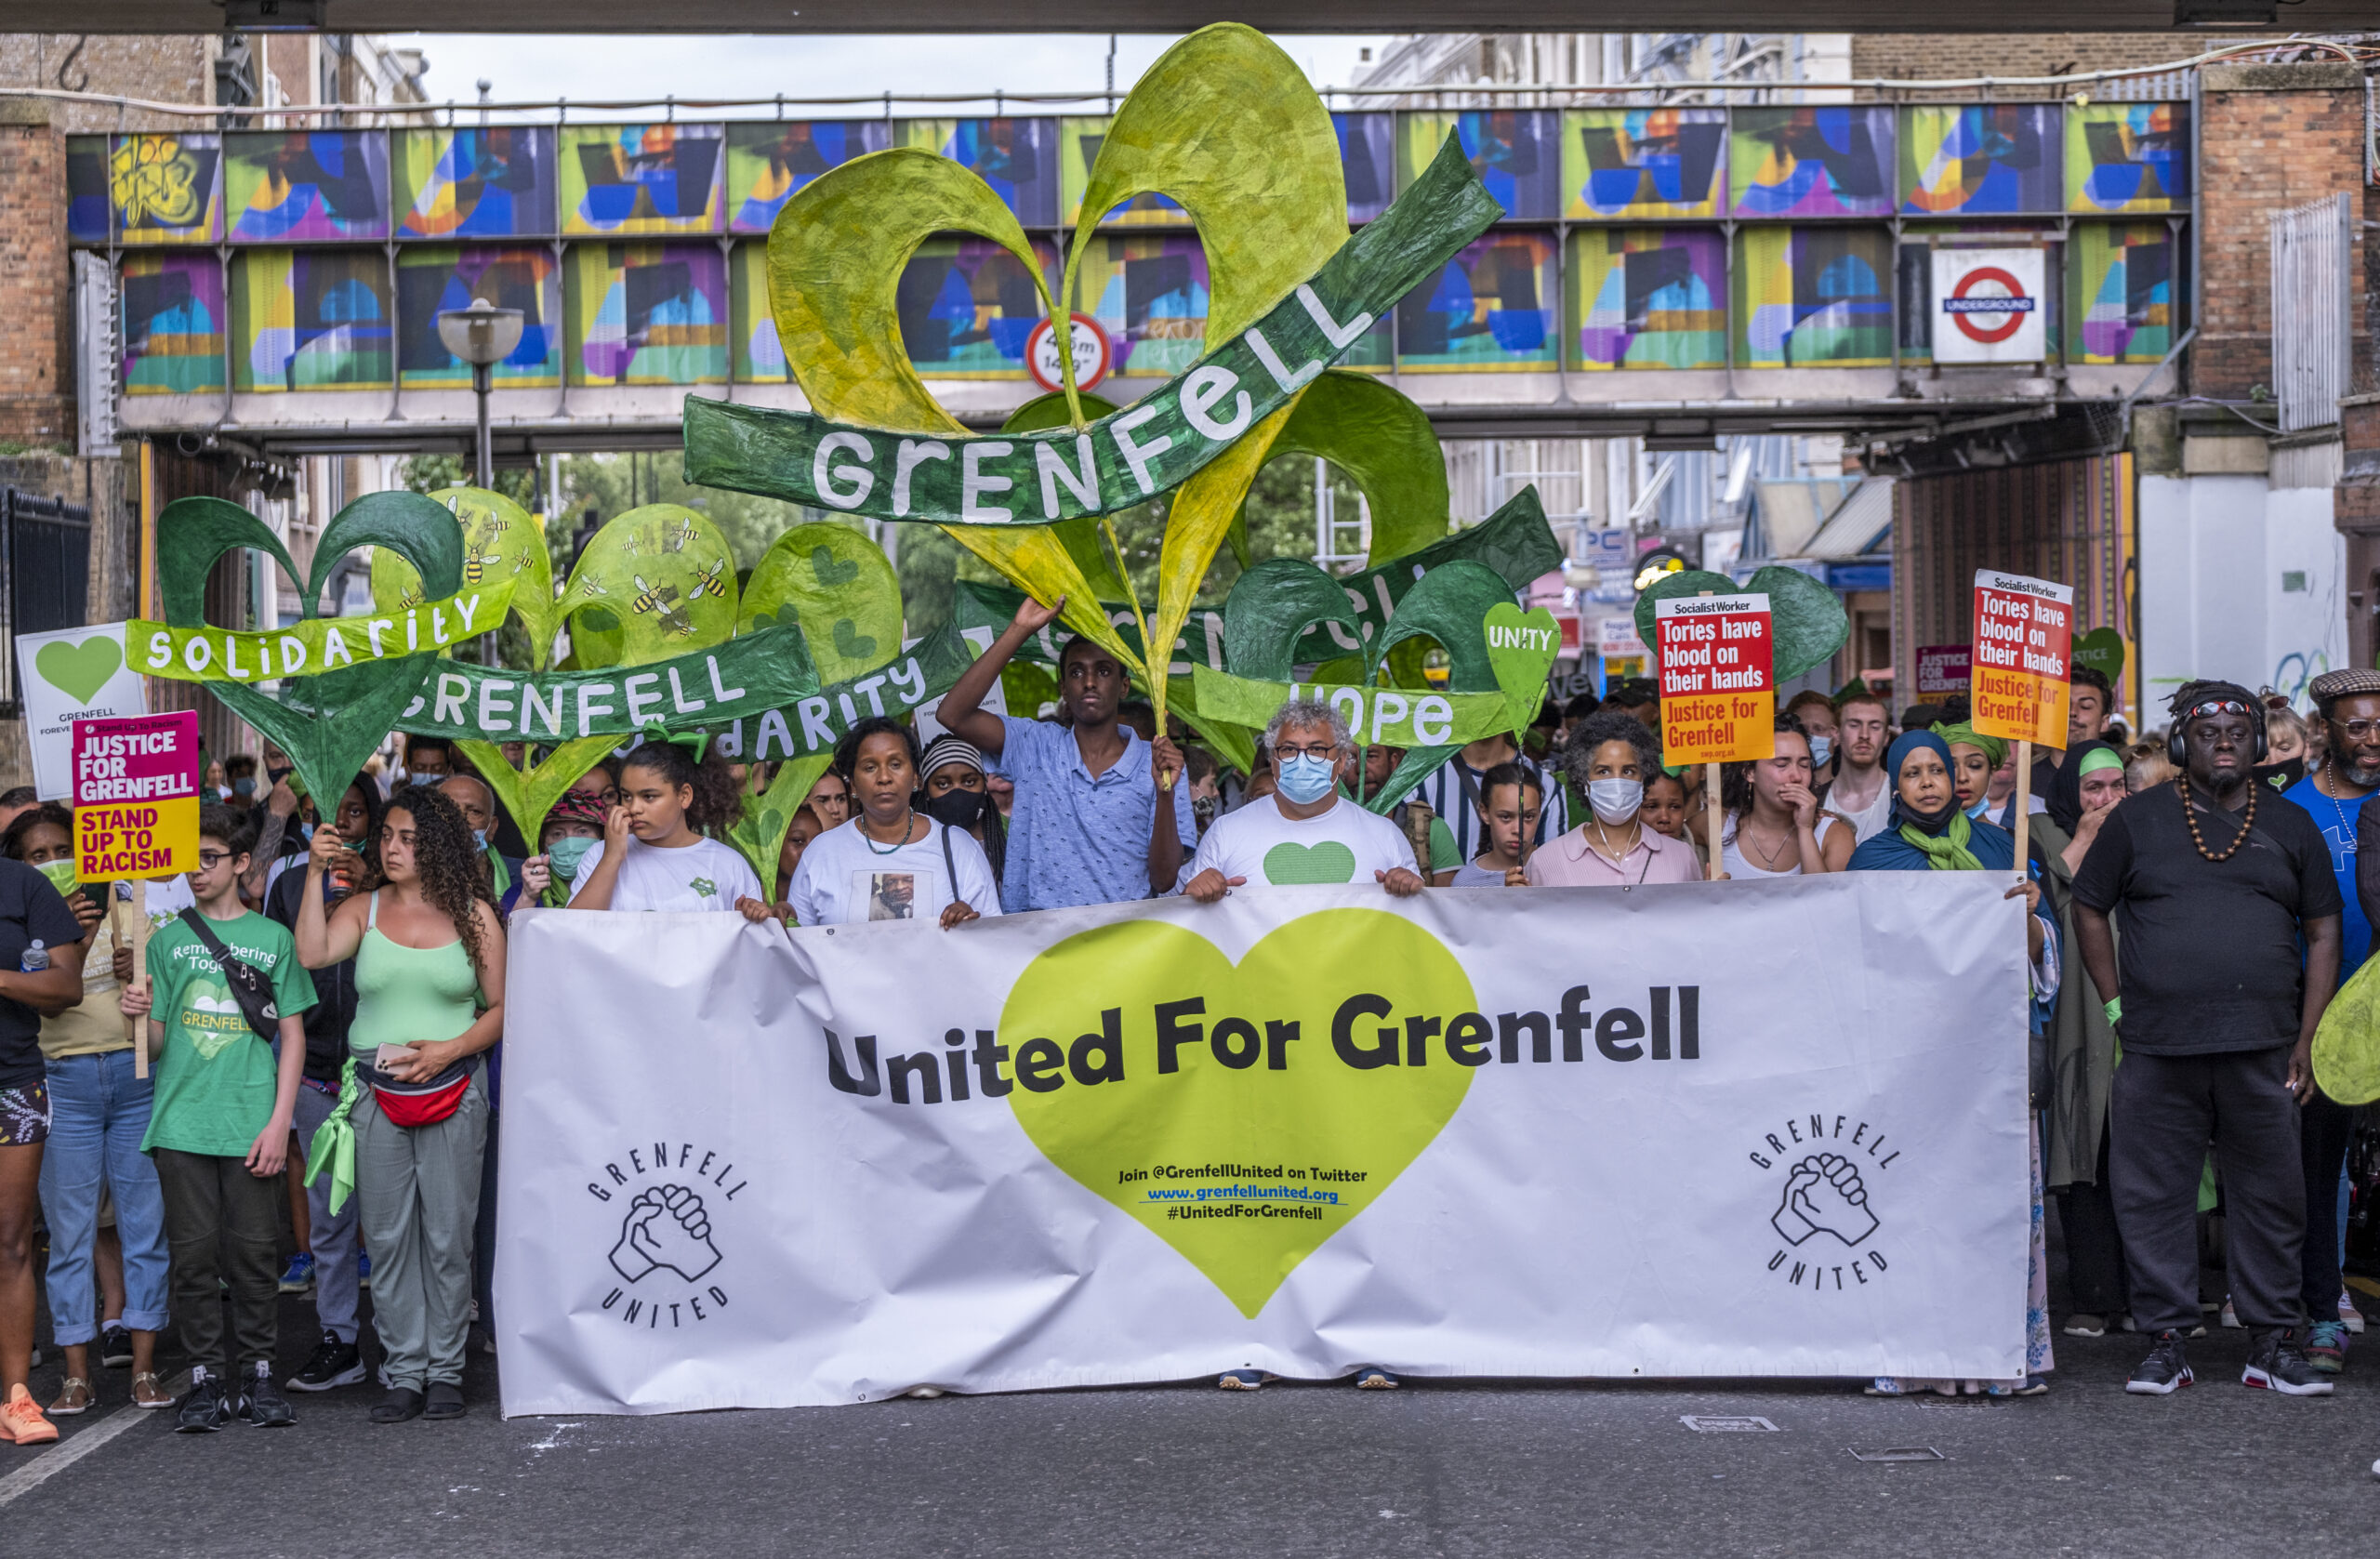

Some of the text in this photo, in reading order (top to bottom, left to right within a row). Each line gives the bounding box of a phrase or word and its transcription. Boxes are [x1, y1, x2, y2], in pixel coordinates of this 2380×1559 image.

[1945, 299, 2032, 311] UNDERGROUND
[1981, 590, 2065, 628] Tories have
[1489, 626, 1553, 652] UNITY
[1661, 616, 1763, 643] Tories have
[1980, 615, 2046, 648] blood on
[1664, 642, 1712, 667] blood
[1717, 646, 1739, 665] on
[1919, 653, 1969, 667] JUSTICE
[1979, 641, 2064, 676] their hands
[2071, 648, 2109, 662] STICE
[1664, 665, 1764, 693] their hands
[1919, 666, 1944, 679] FOR
[1978, 670, 2058, 704] Justice for
[59, 707, 116, 722] GRENFELL
[1667, 697, 1758, 723] Justice for
[1977, 695, 2039, 725] Grenfell
[40, 726, 71, 735] FOREVE
[97, 723, 123, 733] Stand
[139, 722, 150, 731] To
[151, 719, 182, 729] Racism
[1668, 721, 1735, 748] Grenfell
[79, 731, 177, 759] JUSTICE
[1700, 748, 1736, 759] swp.org.uk
[79, 756, 126, 780] FOR
[80, 773, 193, 802] GRENFELL
[82, 808, 158, 831] STAND
[83, 829, 152, 853] UP TO
[83, 848, 172, 874] RACISM
[823, 985, 1700, 1106] United For Grenfell
[1750, 1114, 1900, 1169] GRENFELL
[588, 1142, 747, 1202] GRENFELL
[1118, 1164, 1368, 1184] Join @GrenfellUnited on Twitter
[1148, 1183, 1338, 1204] www.grenfellunited.org
[1167, 1204, 1323, 1220] #UnitedForGrenfell
[1767, 1249, 1887, 1290] UNITED
[602, 1286, 728, 1328] UNITED
